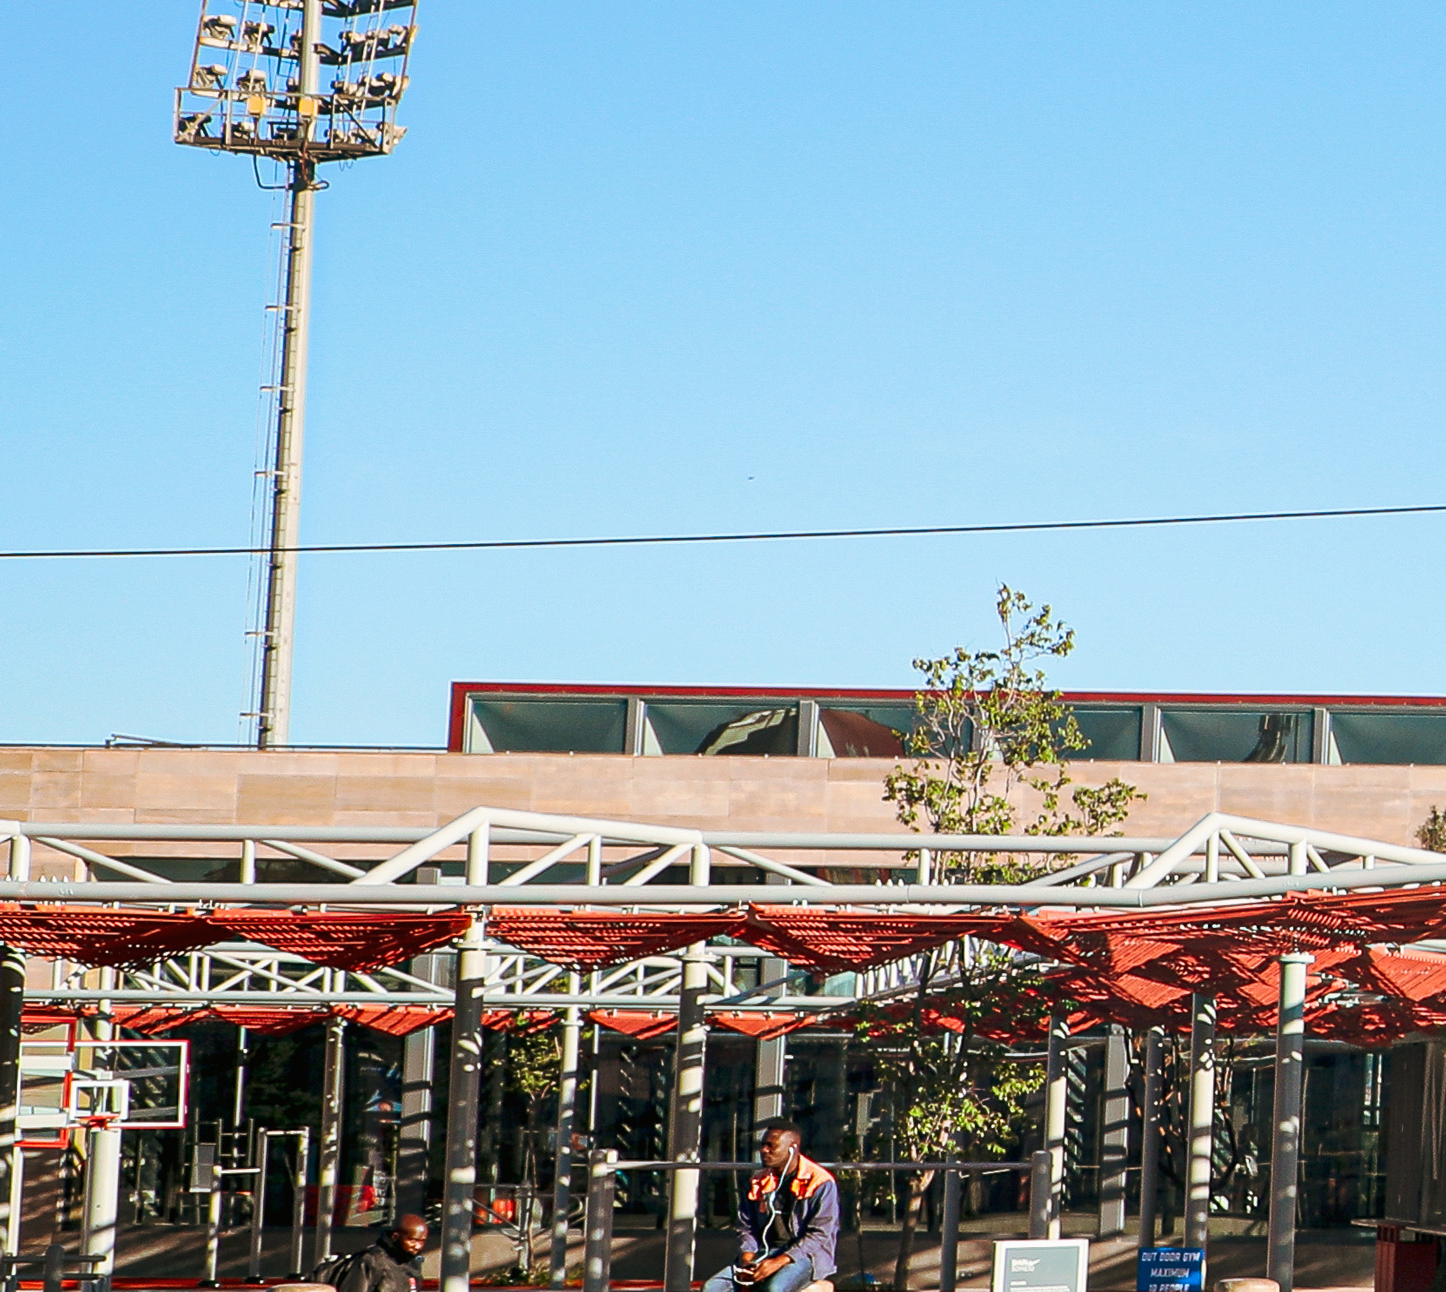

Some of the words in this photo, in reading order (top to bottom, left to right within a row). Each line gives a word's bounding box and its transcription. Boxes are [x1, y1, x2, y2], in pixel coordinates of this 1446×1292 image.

[1141, 1252, 1158, 1262] OUT
[1159, 1252, 1181, 1262] DOOR
[1182, 1252, 1201, 1262] GYM
[1150, 1268, 1190, 1278] MAXIMUM
